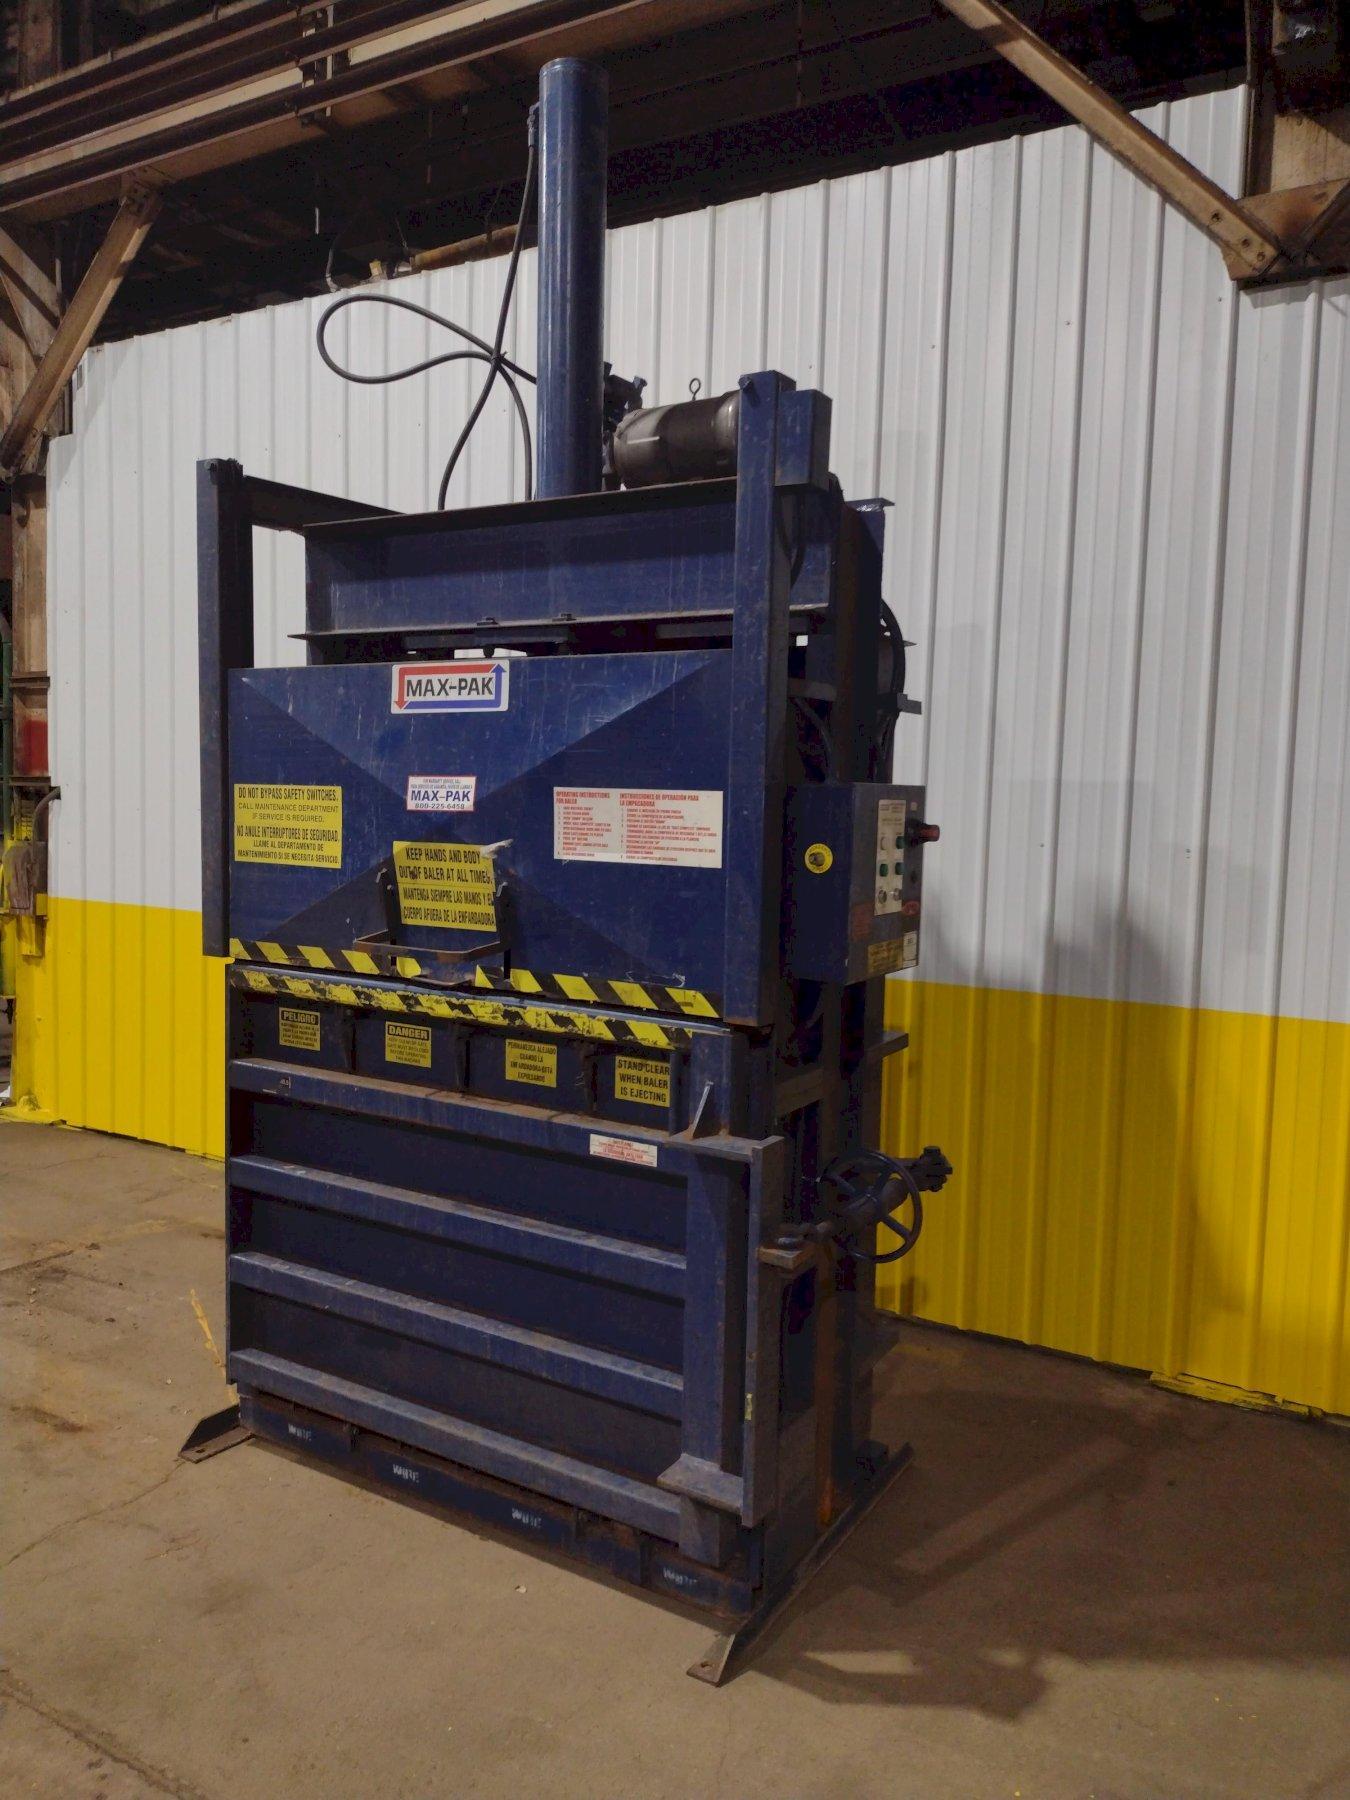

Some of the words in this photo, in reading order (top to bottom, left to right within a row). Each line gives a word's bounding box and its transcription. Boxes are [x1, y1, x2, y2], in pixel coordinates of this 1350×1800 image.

[406, 677, 494, 697] MAX-PAK
[238, 788, 246, 798] DO
[248, 788, 258, 799] NOT
[260, 788, 282, 800] BYPASS
[284, 788, 304, 800] SAFETY
[306, 789, 339, 802] SWITCHES.
[411, 790, 471, 802] MAX-PAK
[238, 802, 254, 810] CALL
[254, 804, 298, 812] MAINTENANCE
[298, 804, 339, 813] DEPARTMENT
[292, 814, 324, 822] REQUIRED.
[236, 826, 244, 836] NO
[244, 826, 260, 838] ANULE
[262, 827, 302, 840] INTERRUPTORES
[302, 828, 309, 840] DE
[254, 840, 269, 848] LLAME
[270, 840, 276, 848] AL
[278, 842, 316, 851] DEPARTAMENTO
[317, 844, 324, 852] DE
[238, 850, 278, 860] MANTENIMIENTO
[291, 852, 314, 862] NECESITA
[406, 848, 422, 861] KEEP
[424, 848, 447, 862] HANDS
[448, 850, 462, 864] AND
[463, 851, 480, 864] BODY
[424, 868, 444, 881] BALER
[446, 868, 454, 881] AT
[456, 870, 468, 882] ALL
[403, 888, 429, 902] MANTENGA
[430, 889, 452, 903] SIEMPRE
[454, 891, 463, 904] LAS
[464, 892, 482, 905] MANOS
[482, 893, 486, 906] Y
[404, 906, 422, 920] CUERPO
[423, 908, 442, 921] AFUERA
[444, 910, 450, 922] DE
[452, 910, 458, 923] LA
[283, 1012, 316, 1024] PELIGRO
[388, 1026, 428, 1040] DANGER
[508, 1041, 536, 1052] PERMANEZCA
[537, 1046, 556, 1055] ALEJADO
[617, 1059, 643, 1072] STAND
[645, 1063, 670, 1076] CLEAR
[619, 1072, 642, 1085] WHEN
[643, 1076, 668, 1089] BALER
[620, 1086, 628, 1096] IS
[630, 1088, 666, 1103] EJECTING
